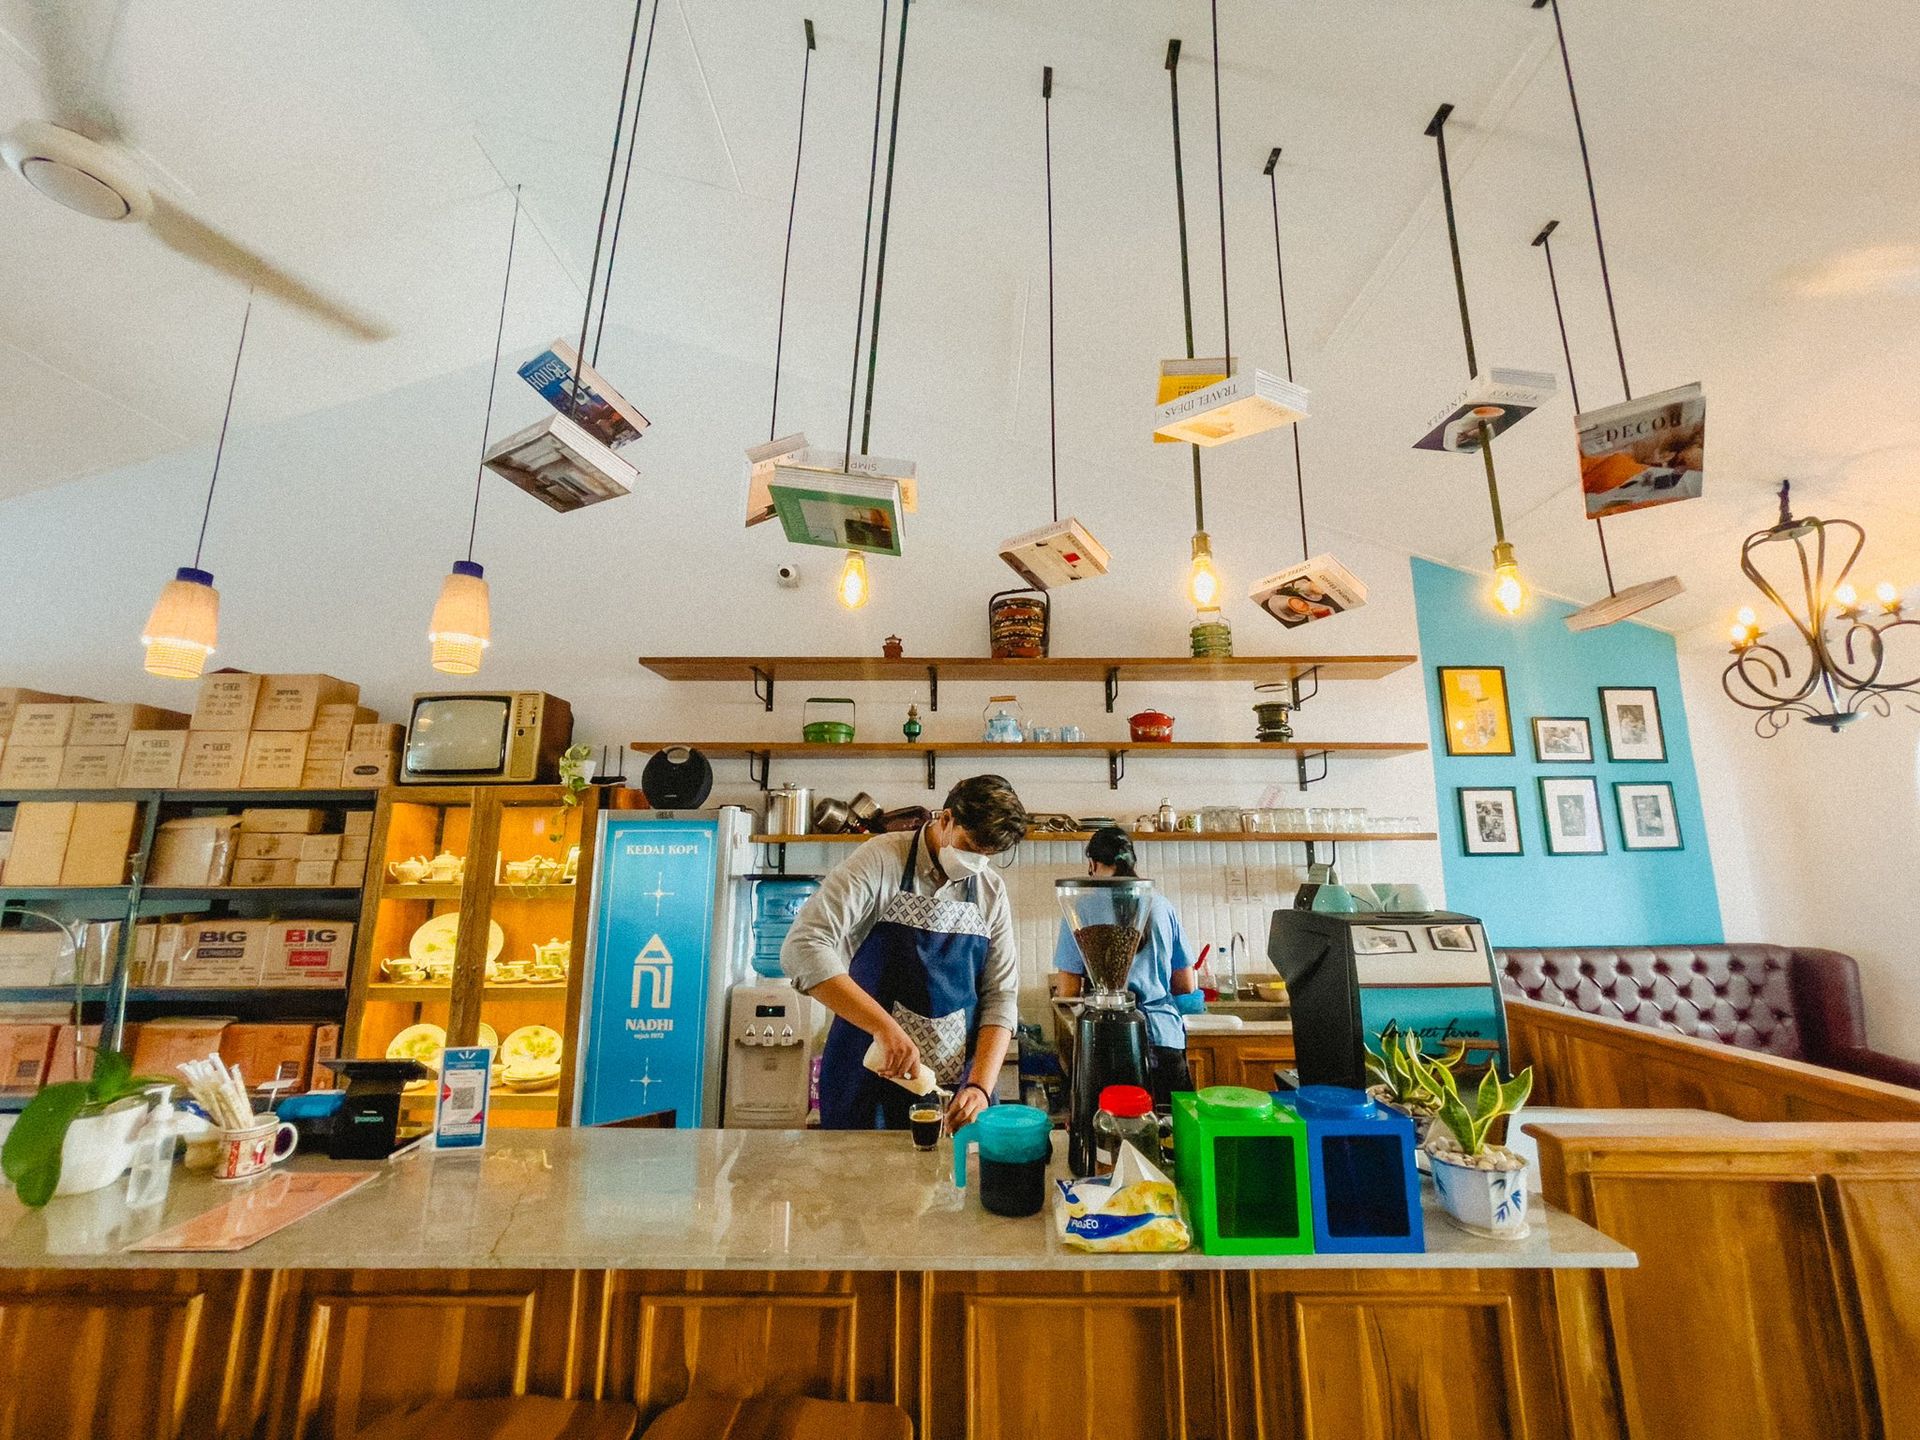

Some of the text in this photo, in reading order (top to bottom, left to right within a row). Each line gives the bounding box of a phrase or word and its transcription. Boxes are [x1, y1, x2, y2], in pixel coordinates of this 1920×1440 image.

[1165, 384, 1238, 418] TRAVEL IDEAS
[1606, 413, 1681, 442] DECOR
[838, 459, 877, 472] SIMPE
[626, 844, 699, 855] KEDAI KOPI
[199, 930, 248, 943] BIG
[285, 929, 338, 943] BIG
[625, 1018, 674, 1031] NADHI
